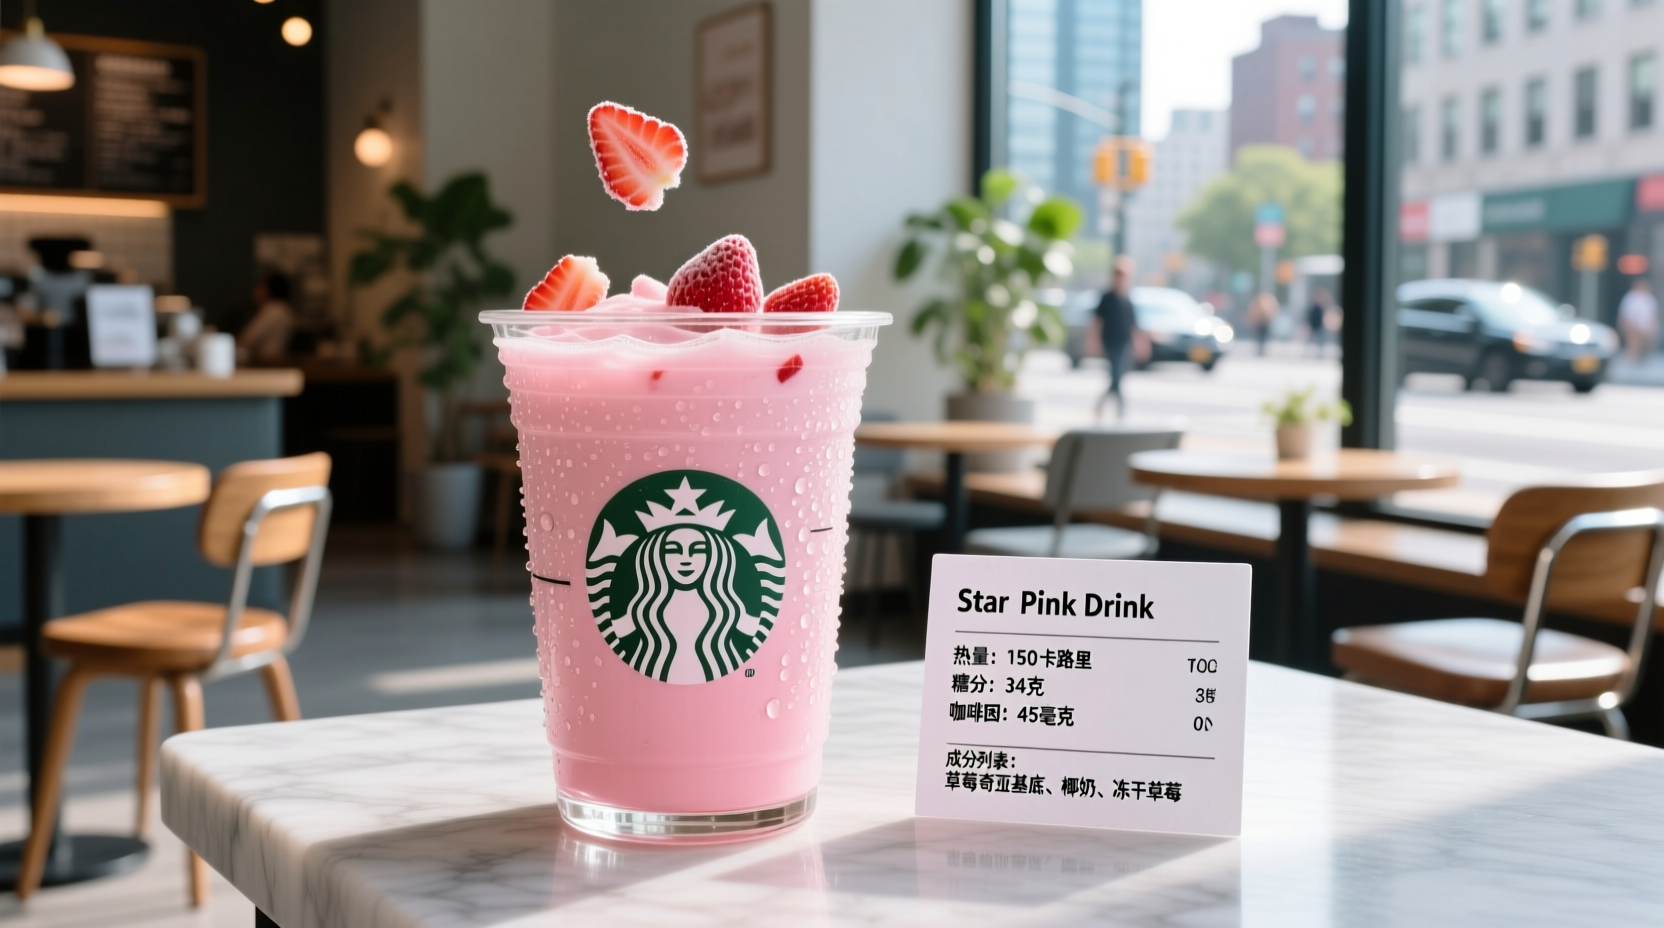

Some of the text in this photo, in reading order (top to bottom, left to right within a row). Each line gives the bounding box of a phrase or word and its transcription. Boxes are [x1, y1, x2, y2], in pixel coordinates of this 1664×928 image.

[957, 587, 1155, 620] Star Pink Drink
